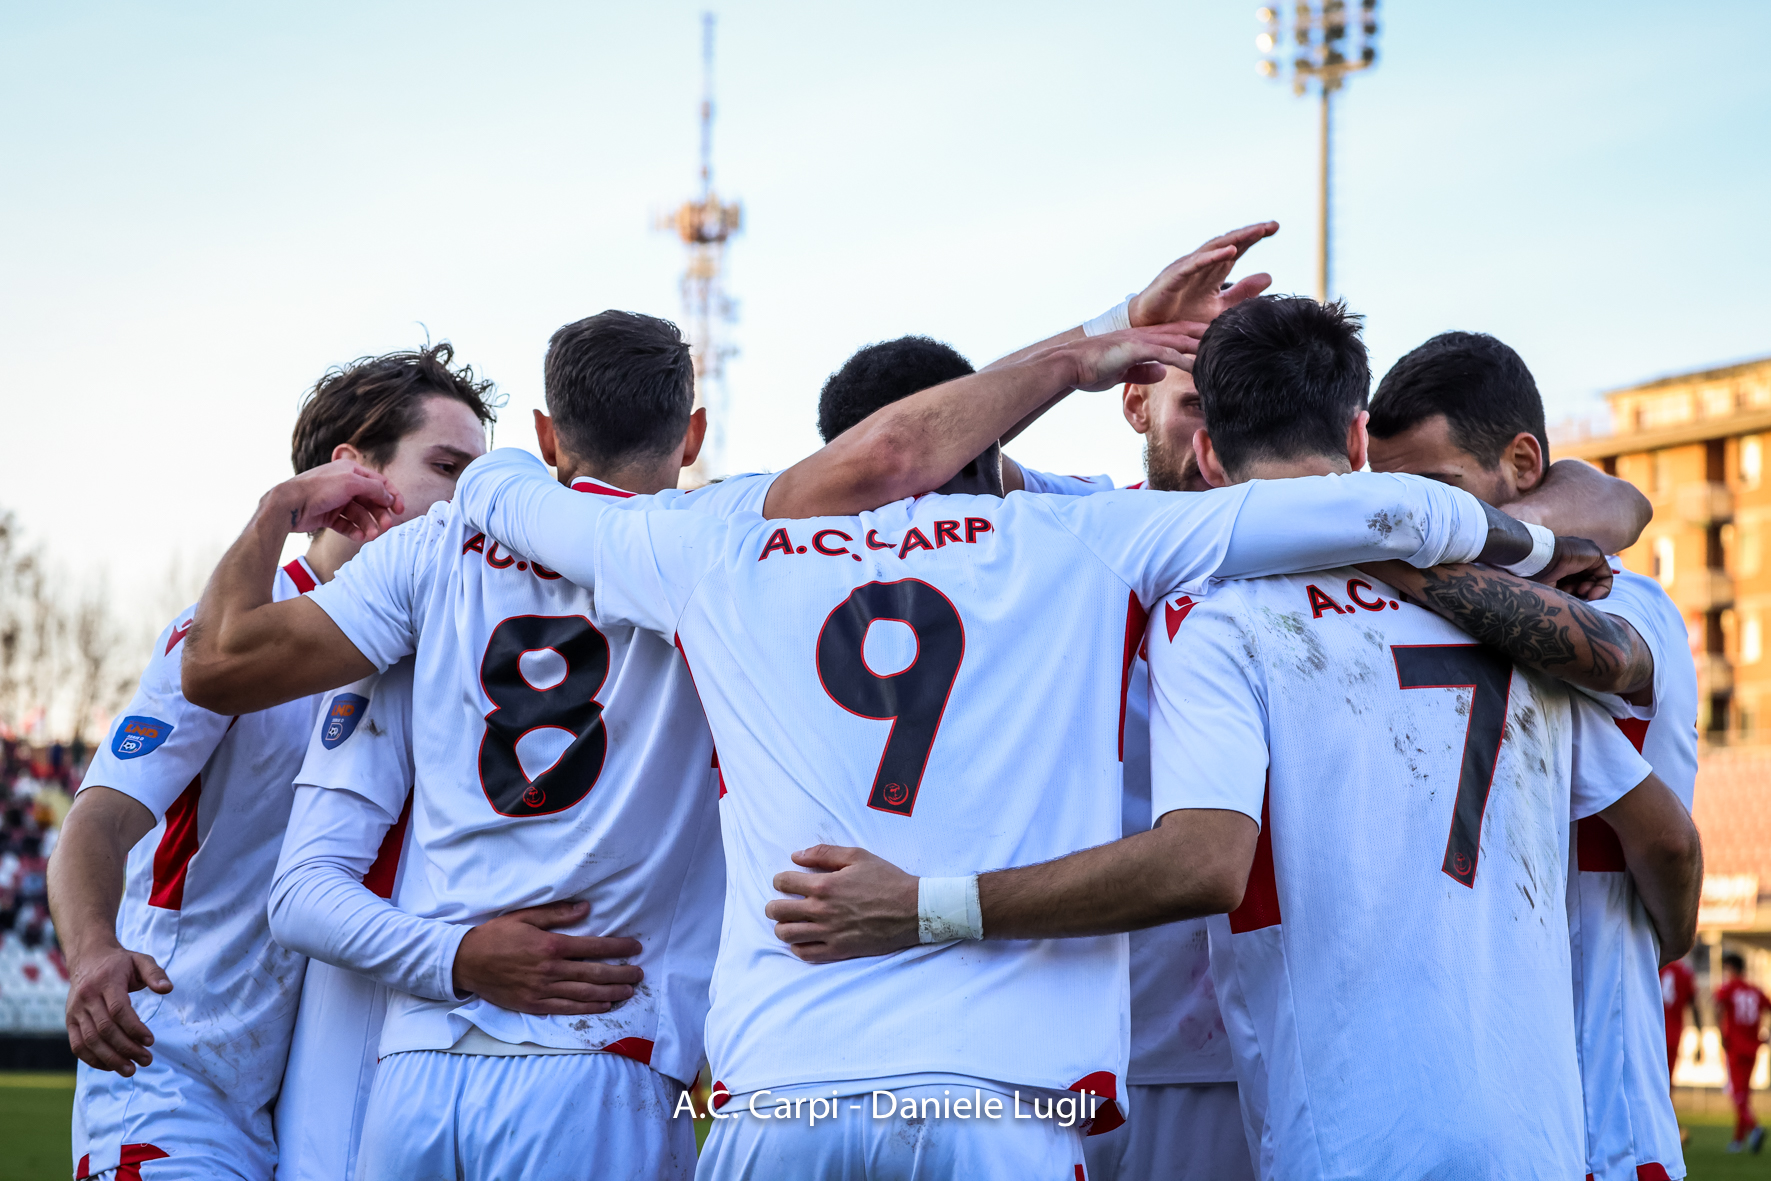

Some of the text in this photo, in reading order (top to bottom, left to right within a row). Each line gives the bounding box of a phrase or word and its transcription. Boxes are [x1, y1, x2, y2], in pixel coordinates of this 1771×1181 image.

[758, 517, 995, 562] A.C. CARP
[1306, 578, 1399, 619] A.C.
[331, 704, 355, 717] LND
[478, 614, 609, 818] 8
[816, 577, 965, 817] 9
[124, 723, 158, 738] LND
[1390, 644, 1513, 889] 7
